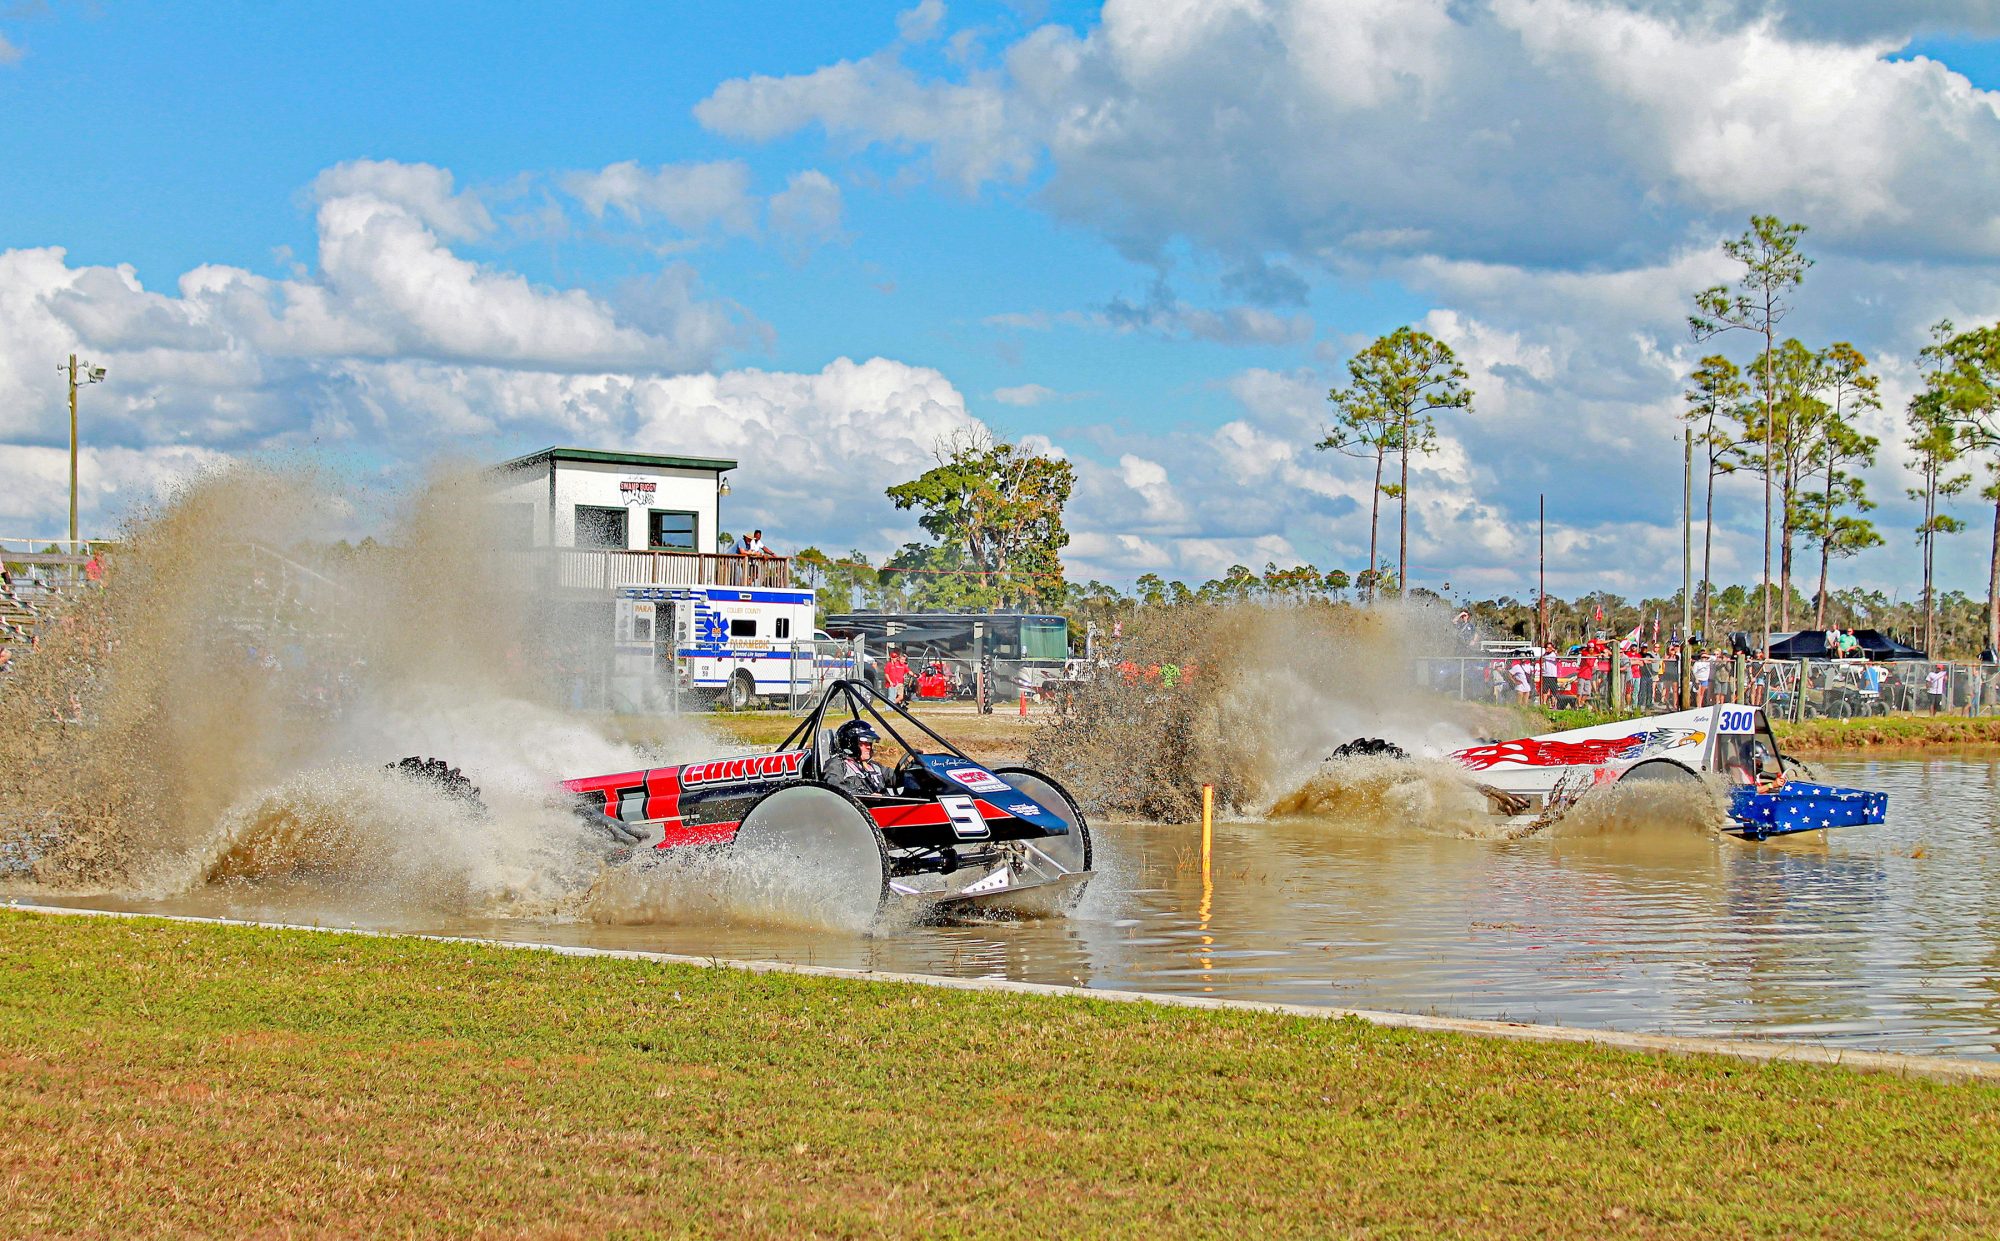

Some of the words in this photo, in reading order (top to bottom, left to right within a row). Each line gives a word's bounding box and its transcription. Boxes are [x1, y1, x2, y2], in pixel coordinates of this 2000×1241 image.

[620, 482, 639, 490] SWAMP
[730, 639, 769, 649] PARAMEDIC
[1720, 711, 1753, 731] 300
[682, 751, 806, 787] CONVOY
[937, 796, 990, 838] 5
